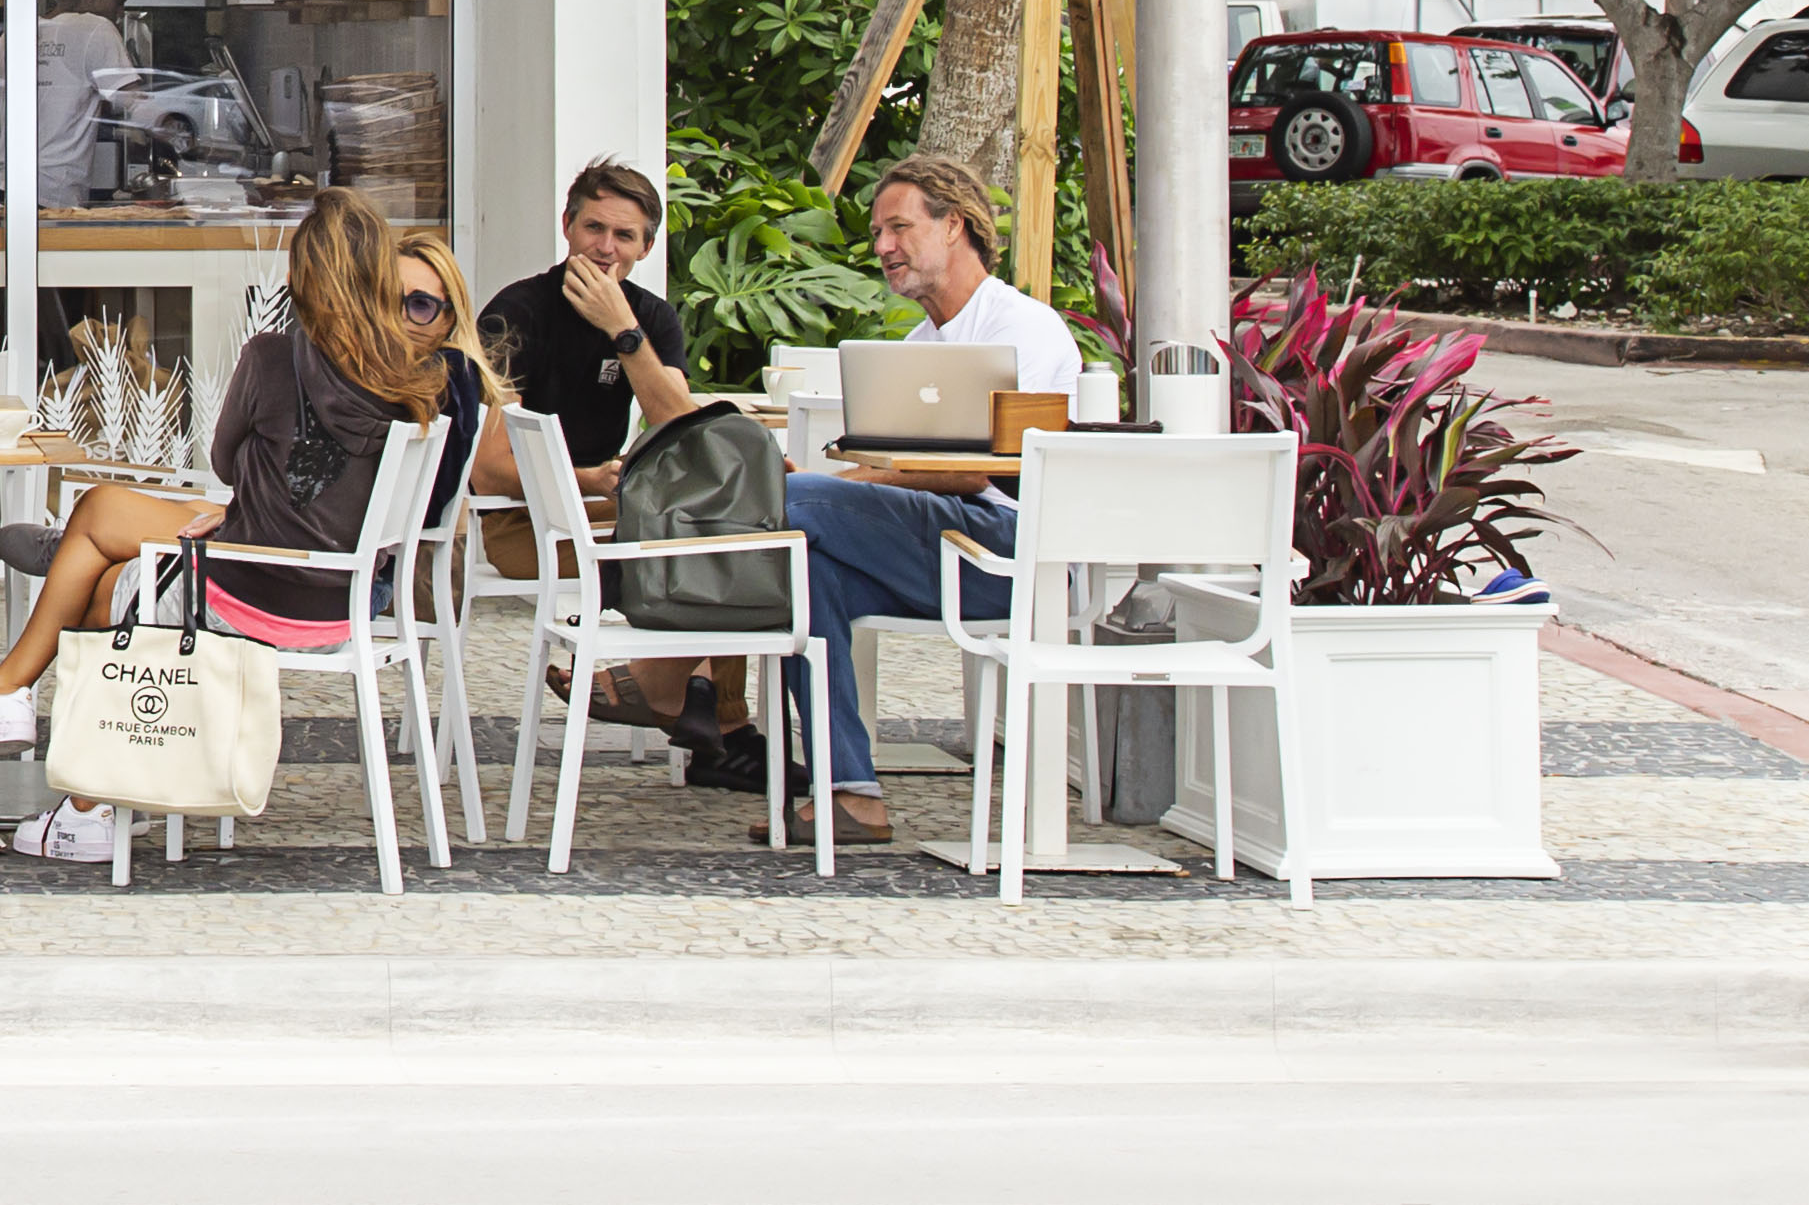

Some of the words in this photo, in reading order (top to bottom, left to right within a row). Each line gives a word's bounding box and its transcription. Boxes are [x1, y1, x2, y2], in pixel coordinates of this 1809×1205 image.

[101, 662, 199, 686] CHANEL
[99, 720, 113, 731] 31
[115, 722, 141, 734] RUE
[143, 724, 197, 738] CAMBON
[129, 734, 165, 747] PARIS
